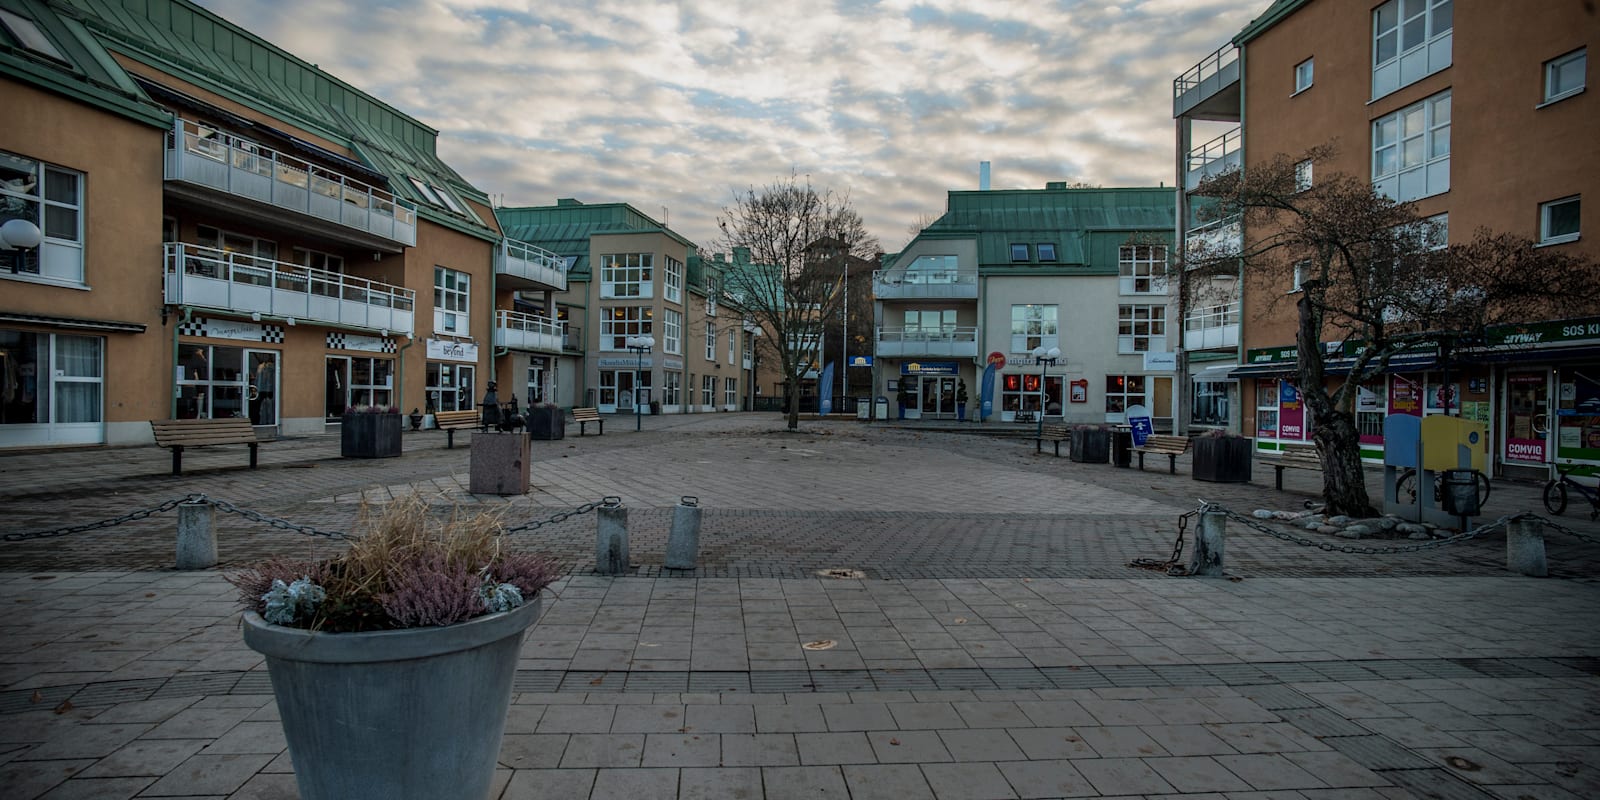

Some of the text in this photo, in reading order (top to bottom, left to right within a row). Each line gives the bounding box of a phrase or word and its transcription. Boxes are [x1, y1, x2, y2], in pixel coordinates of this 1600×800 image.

[1562, 323, 1600, 336] SOS KI
[1508, 443, 1543, 455] COMVIQ
